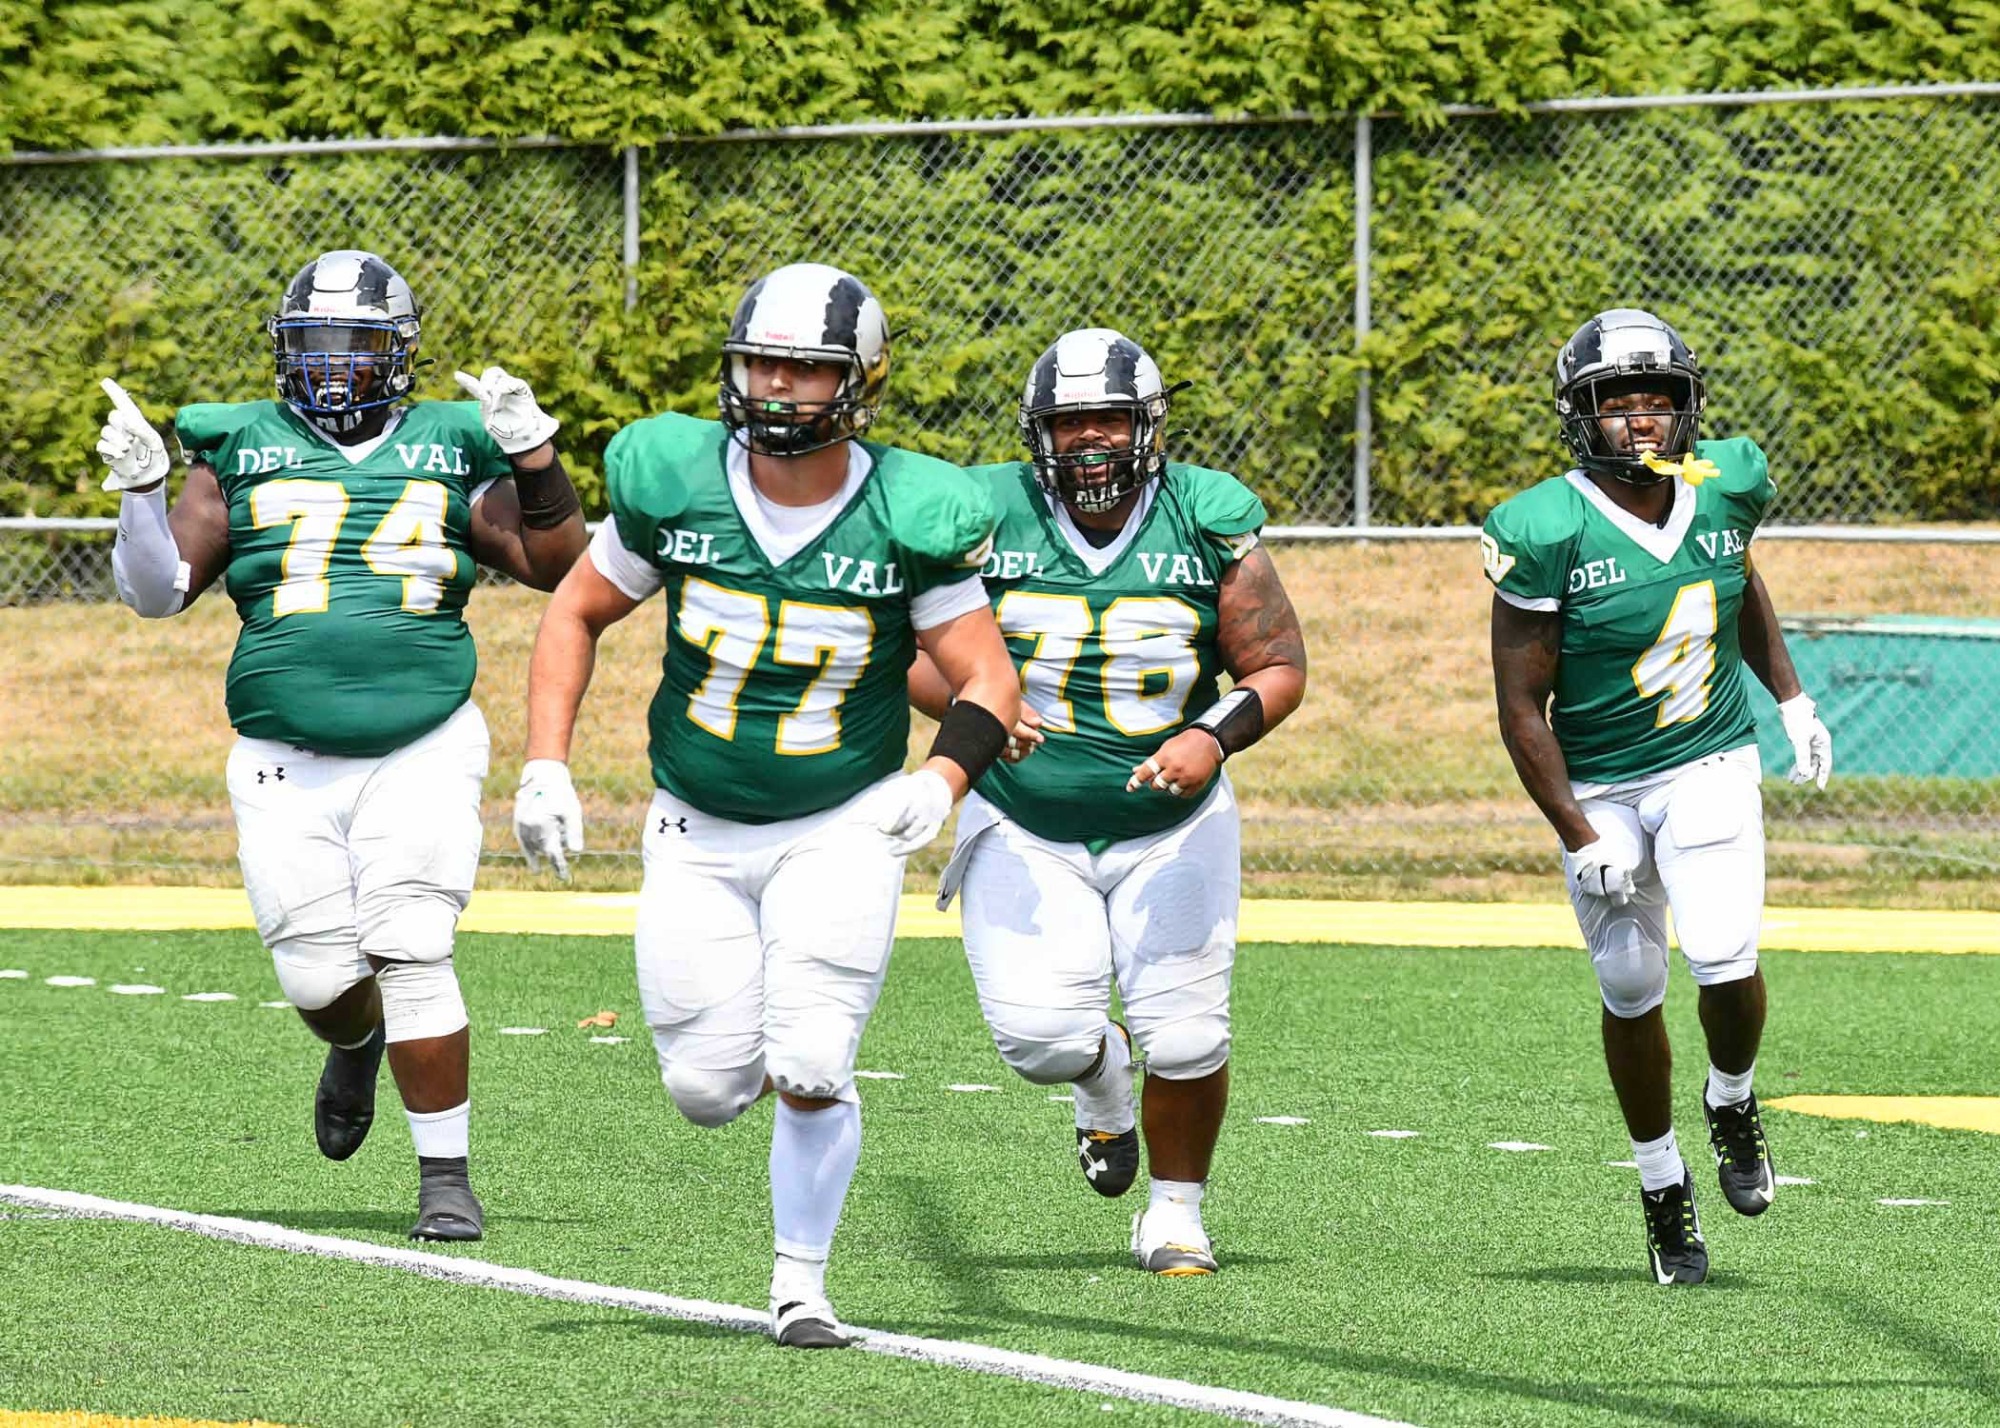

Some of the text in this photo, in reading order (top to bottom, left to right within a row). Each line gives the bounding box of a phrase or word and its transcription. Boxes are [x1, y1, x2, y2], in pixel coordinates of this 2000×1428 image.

[237, 444, 471, 476] DEL VAL
[250, 478, 458, 617] 74
[822, 551, 904, 596] VAL
[1136, 552, 1215, 586] VAL
[1567, 529, 1745, 595] DEL VAL
[677, 574, 877, 756] 77
[996, 590, 1201, 737] 78
[1630, 578, 1718, 729] 4
